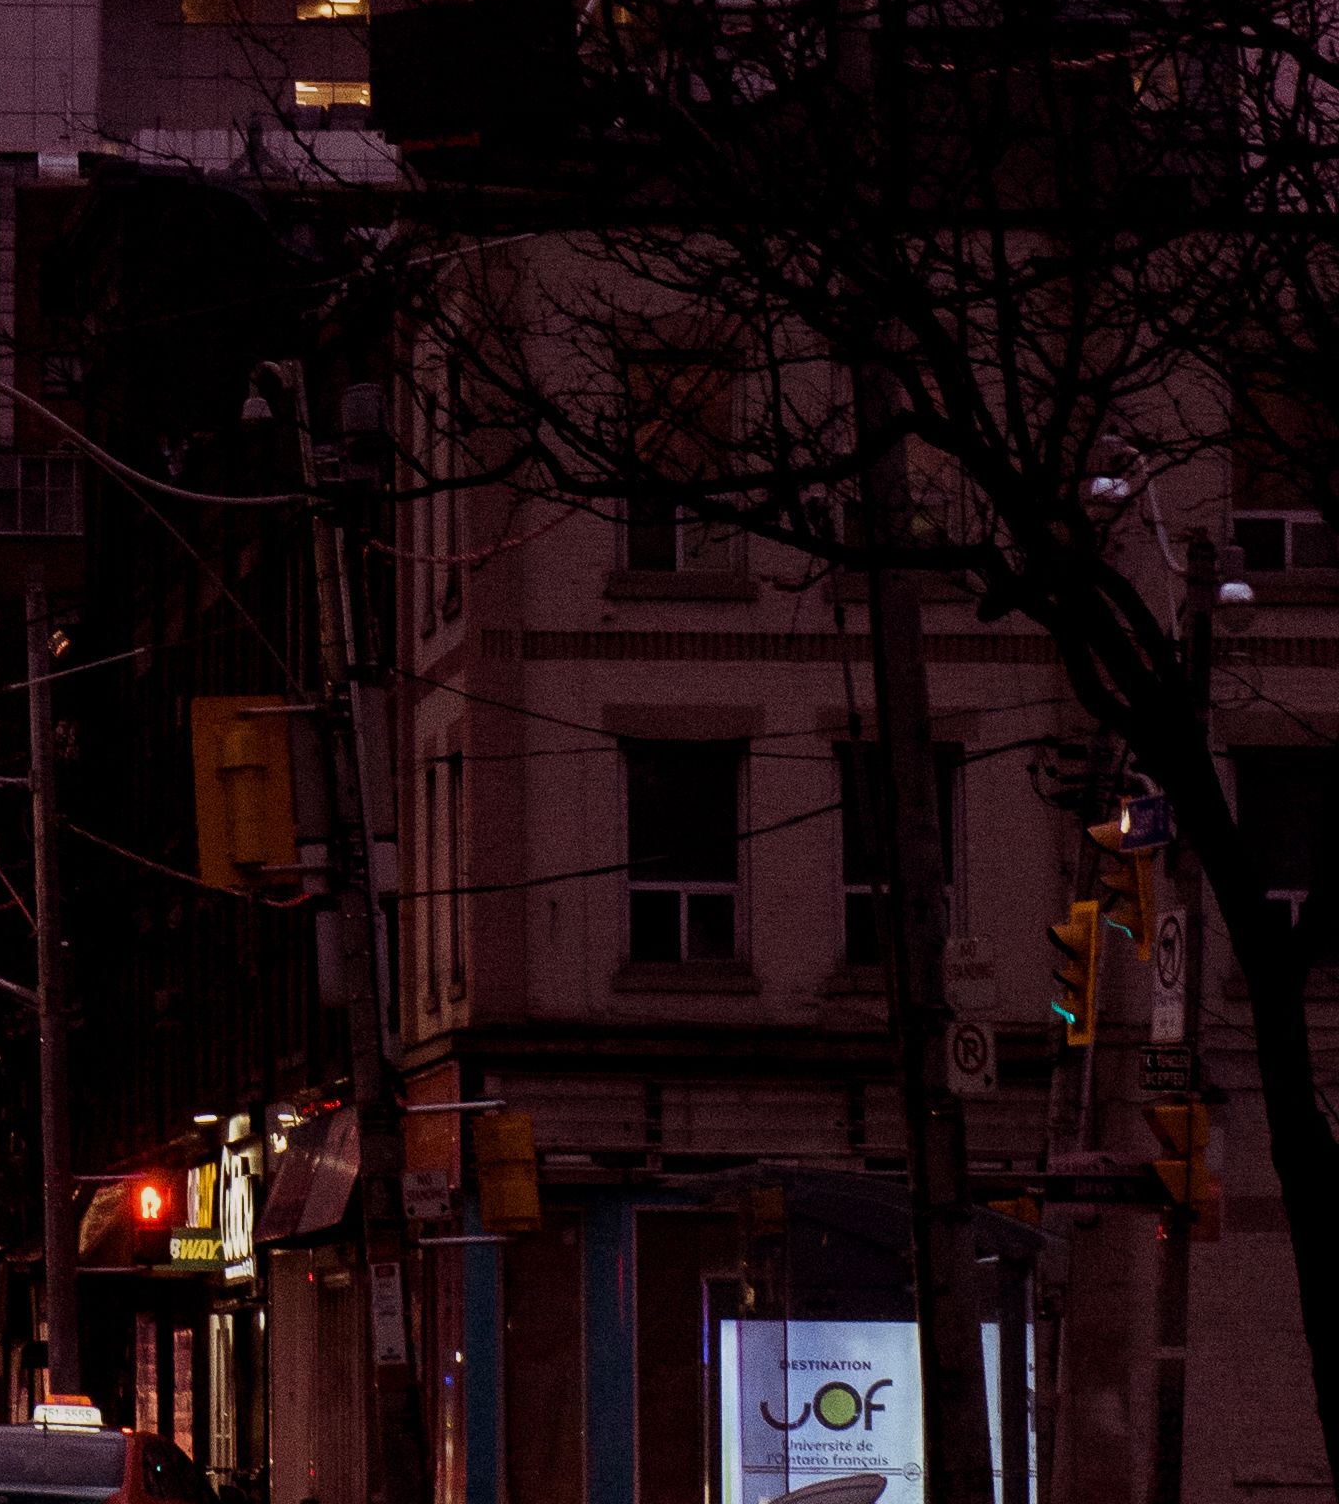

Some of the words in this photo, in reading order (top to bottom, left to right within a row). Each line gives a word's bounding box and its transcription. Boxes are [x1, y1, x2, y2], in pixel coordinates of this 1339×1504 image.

[417, 1173, 432, 1185] NO
[779, 1359, 872, 1371] DESTINATION
[782, 1438, 853, 1453] Université
[856, 1439, 874, 1453] de
[833, 1453, 889, 1469] français
